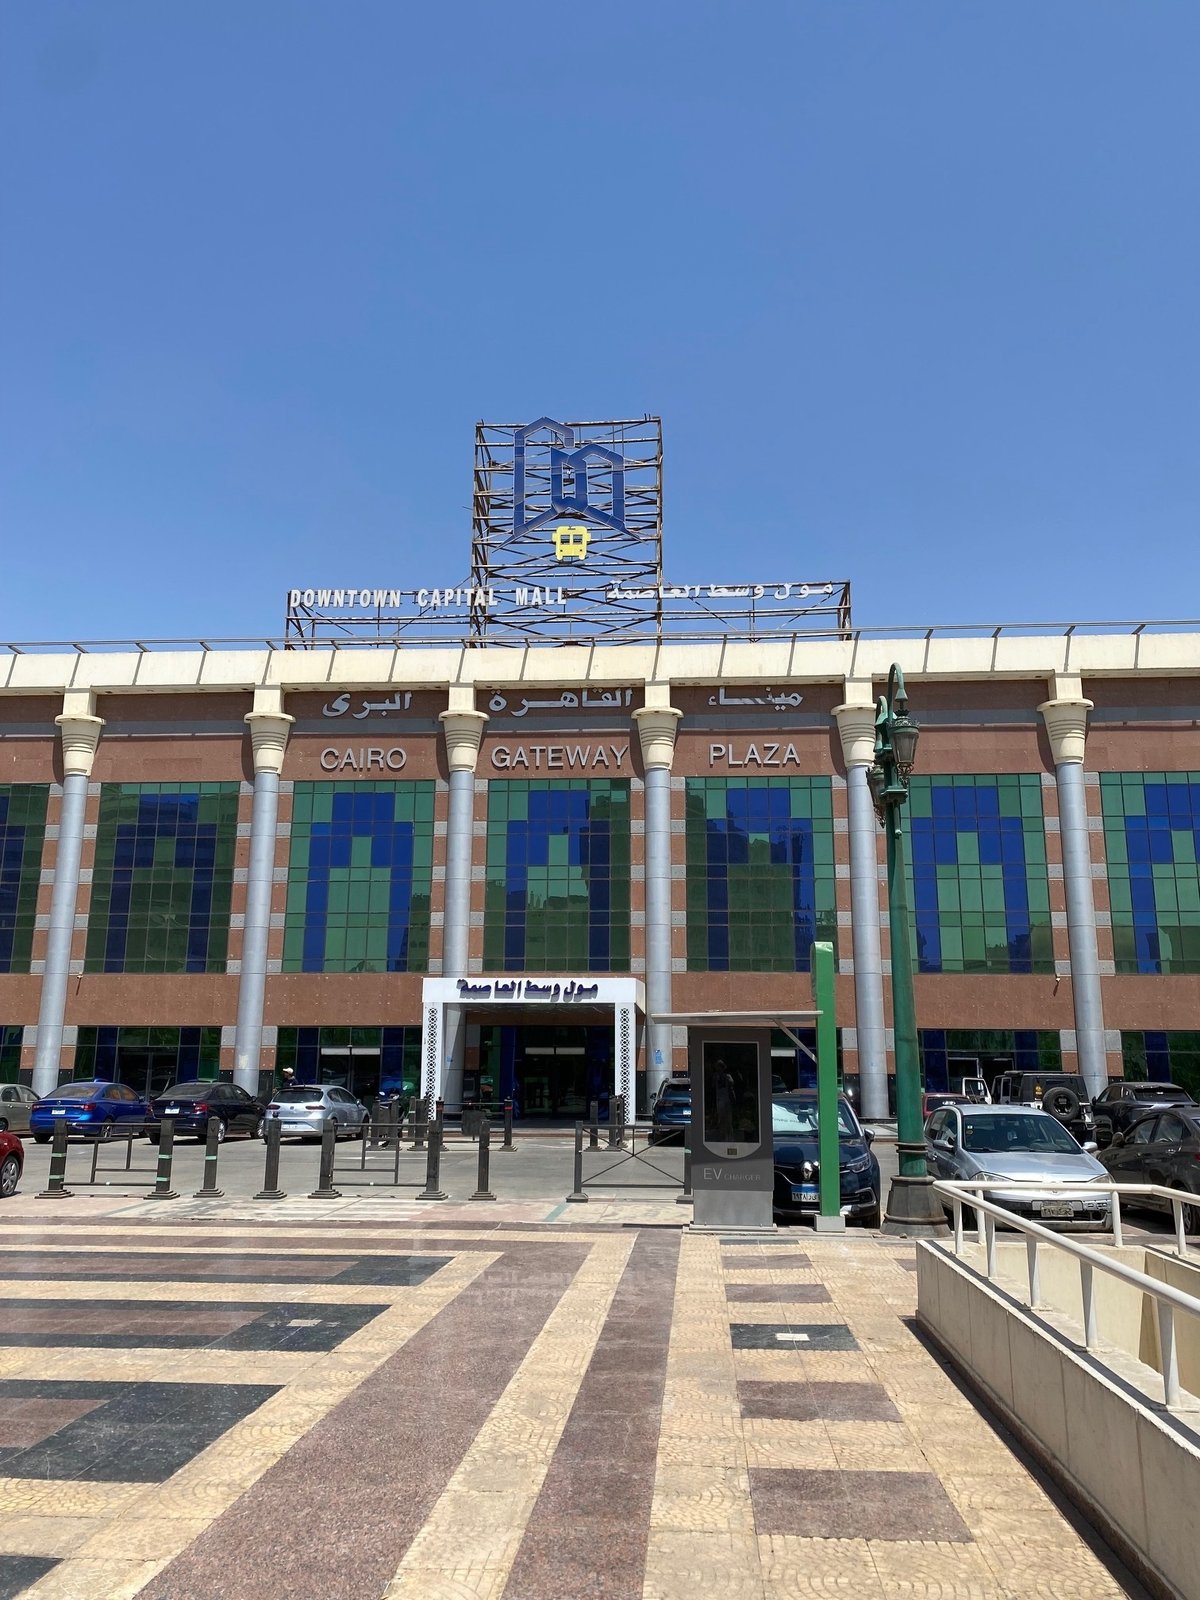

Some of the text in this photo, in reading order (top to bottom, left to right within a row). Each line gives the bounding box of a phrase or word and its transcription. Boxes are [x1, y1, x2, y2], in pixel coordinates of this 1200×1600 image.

[290, 586, 568, 608] DOWNTOWN CAPITAL MALL
[606, 579, 834, 600] مول وسط العاصمة
[488, 687, 633, 718] القاهرة
[708, 686, 804, 712] ميناء
[320, 743, 801, 769] CAIRO GATEWAY PLAZA
[456, 978, 599, 1002] مول وسط العاصمة
[703, 1167, 761, 1181] EV CHARGER
